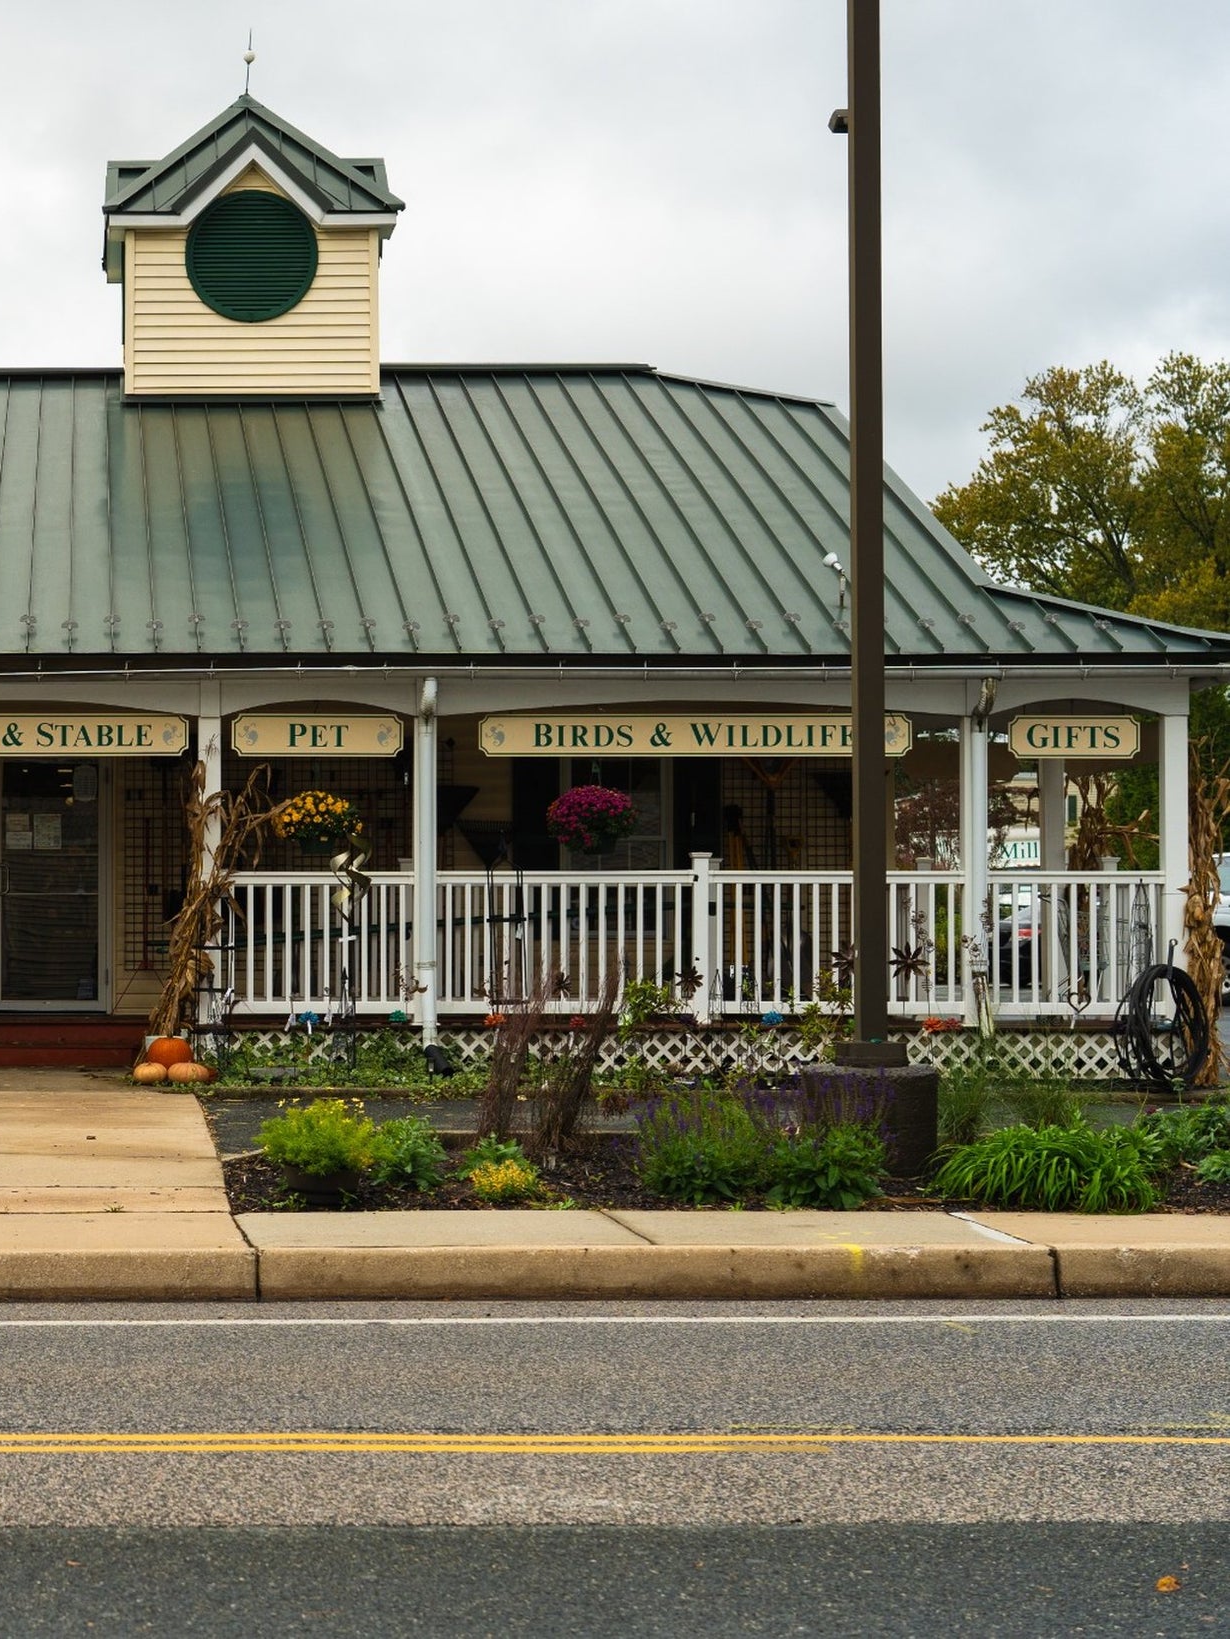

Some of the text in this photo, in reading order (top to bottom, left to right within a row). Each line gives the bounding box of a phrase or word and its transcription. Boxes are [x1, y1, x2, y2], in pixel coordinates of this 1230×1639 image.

[1, 722, 24, 748] &
[36, 722, 154, 748] STABLE
[287, 723, 349, 748] PET
[533, 722, 634, 748] BIRDS
[649, 722, 673, 748] &
[1026, 723, 1121, 749] GIFTS
[998, 841, 1038, 859] Mill
